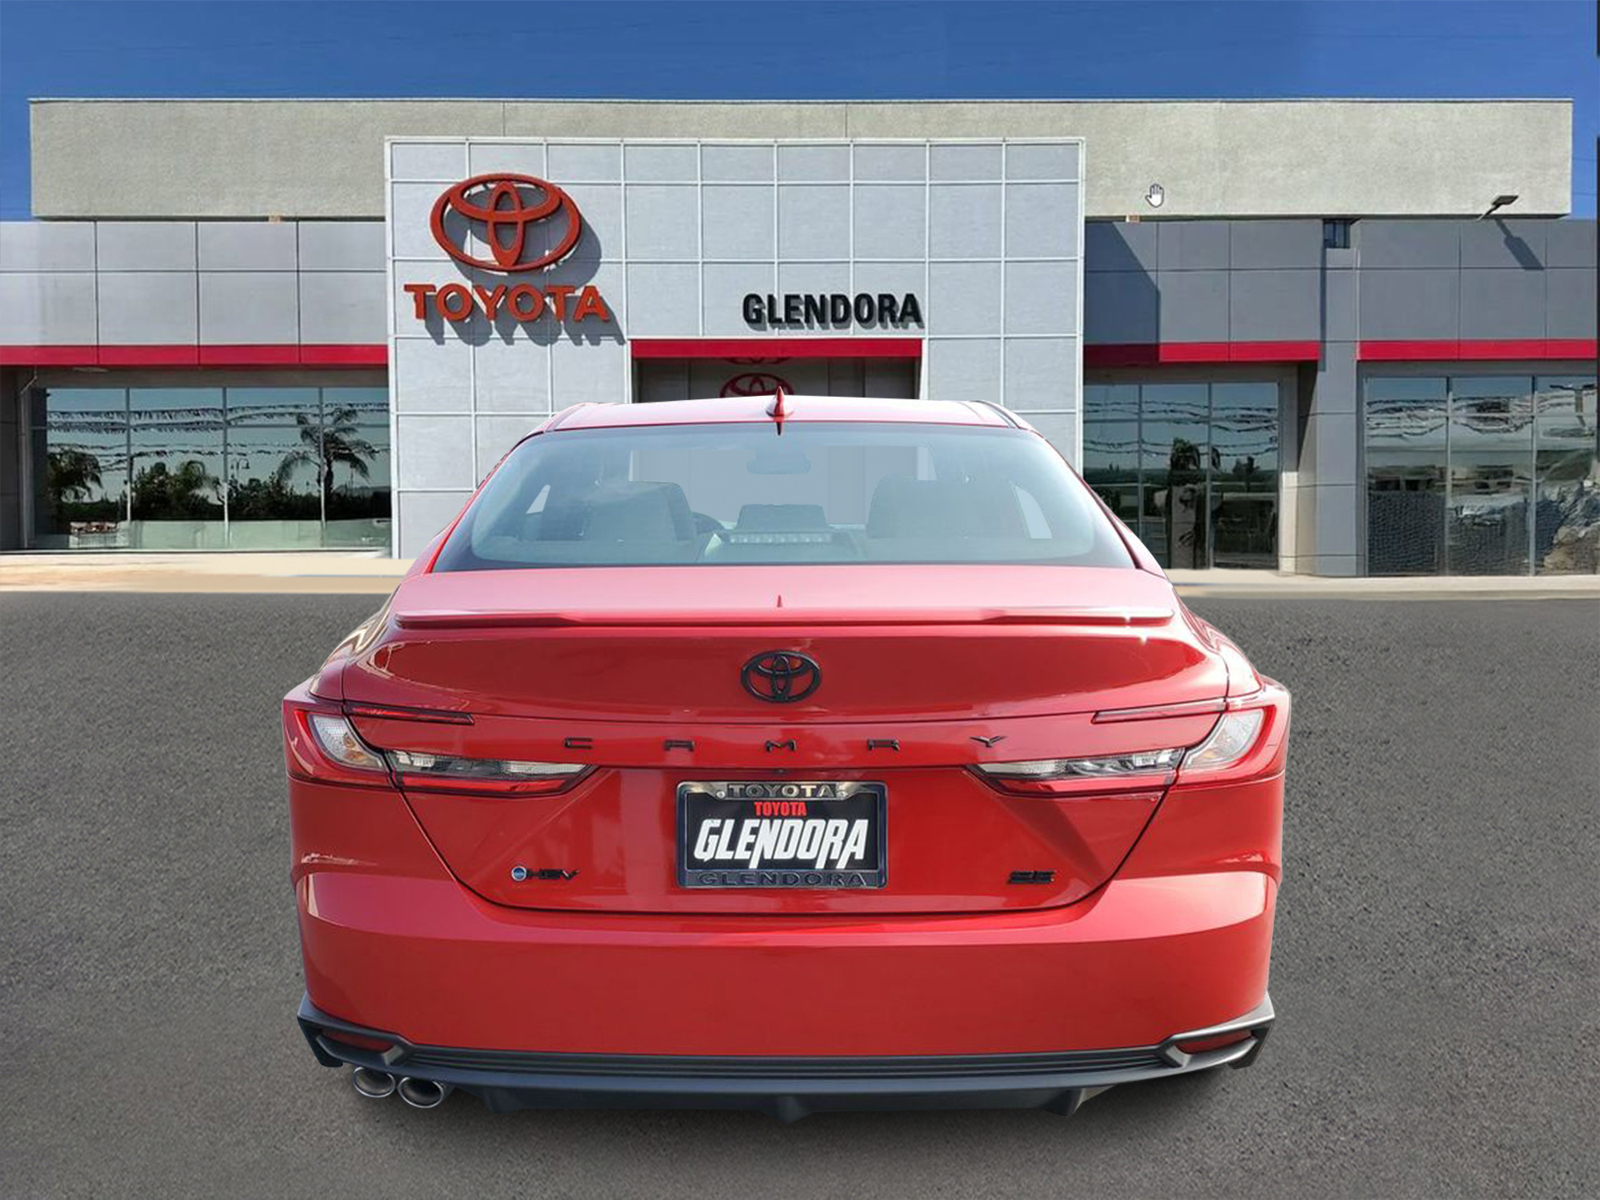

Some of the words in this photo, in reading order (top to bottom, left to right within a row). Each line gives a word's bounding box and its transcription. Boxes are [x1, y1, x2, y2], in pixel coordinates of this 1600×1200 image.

[403, 283, 610, 322] TOYOTA
[742, 292, 922, 325] GLENDORA
[564, 735, 1007, 752] CAMRY
[728, 783, 837, 798] TOYOTA
[754, 801, 807, 816] TOYOTA
[693, 818, 869, 869] GLENDORA
[698, 872, 867, 887] GLENDORA
